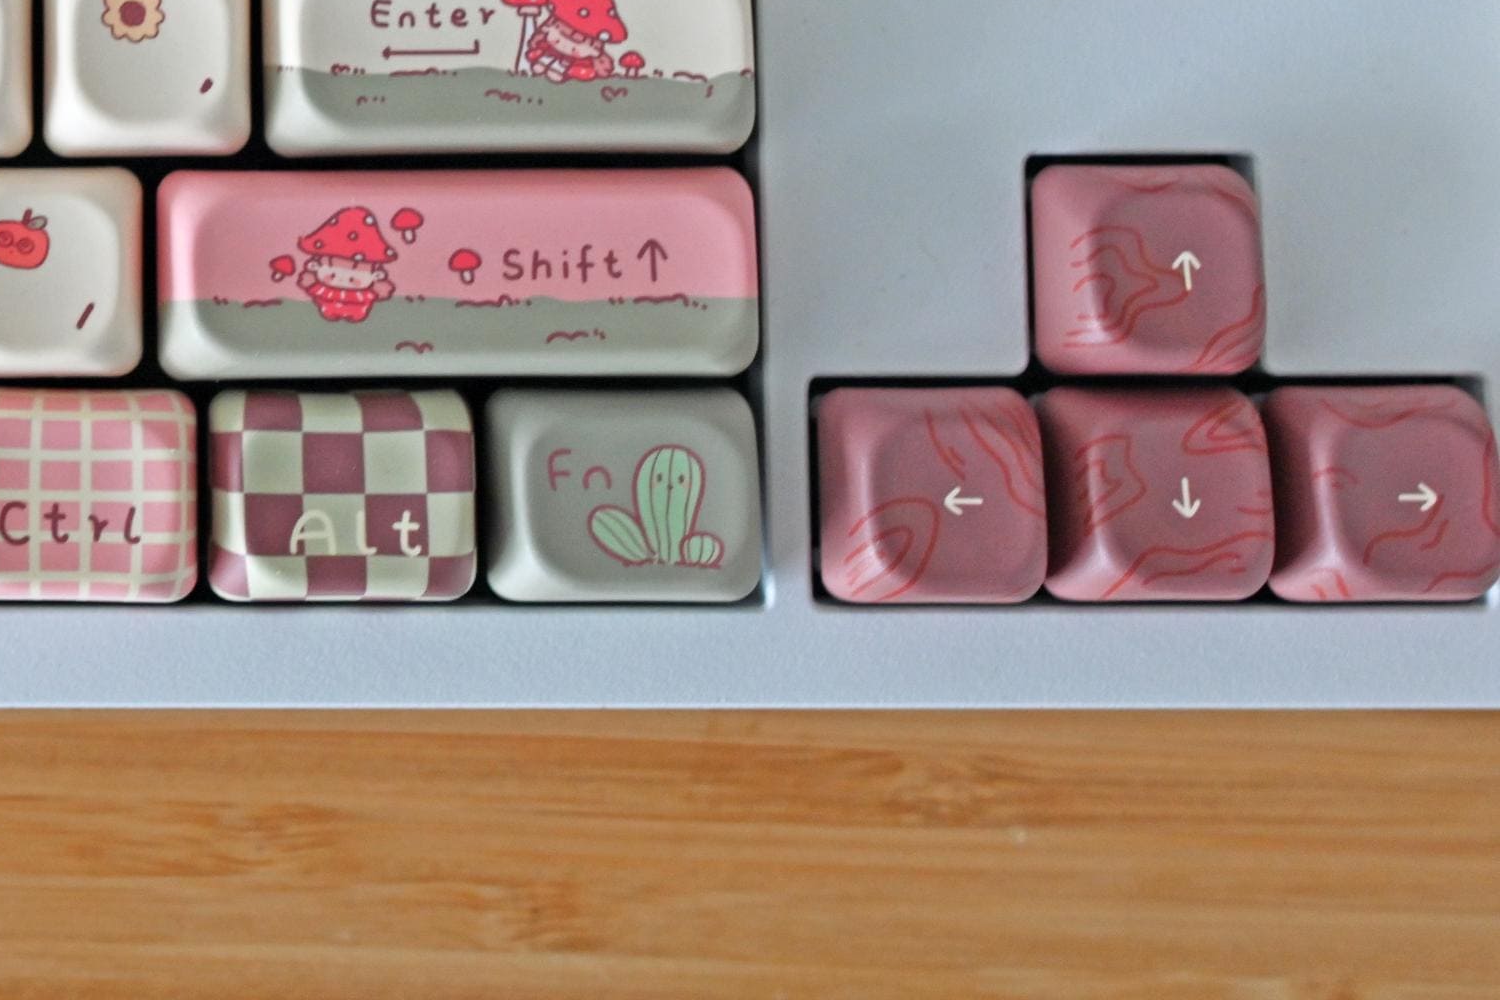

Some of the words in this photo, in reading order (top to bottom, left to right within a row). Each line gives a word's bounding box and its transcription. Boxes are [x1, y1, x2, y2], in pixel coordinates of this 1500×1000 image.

[371, 0, 495, 29] Enter
[503, 244, 622, 283] Shift
[76, 303, 94, 329] /
[547, 448, 612, 491] Fn
[289, 511, 422, 557] Alt
